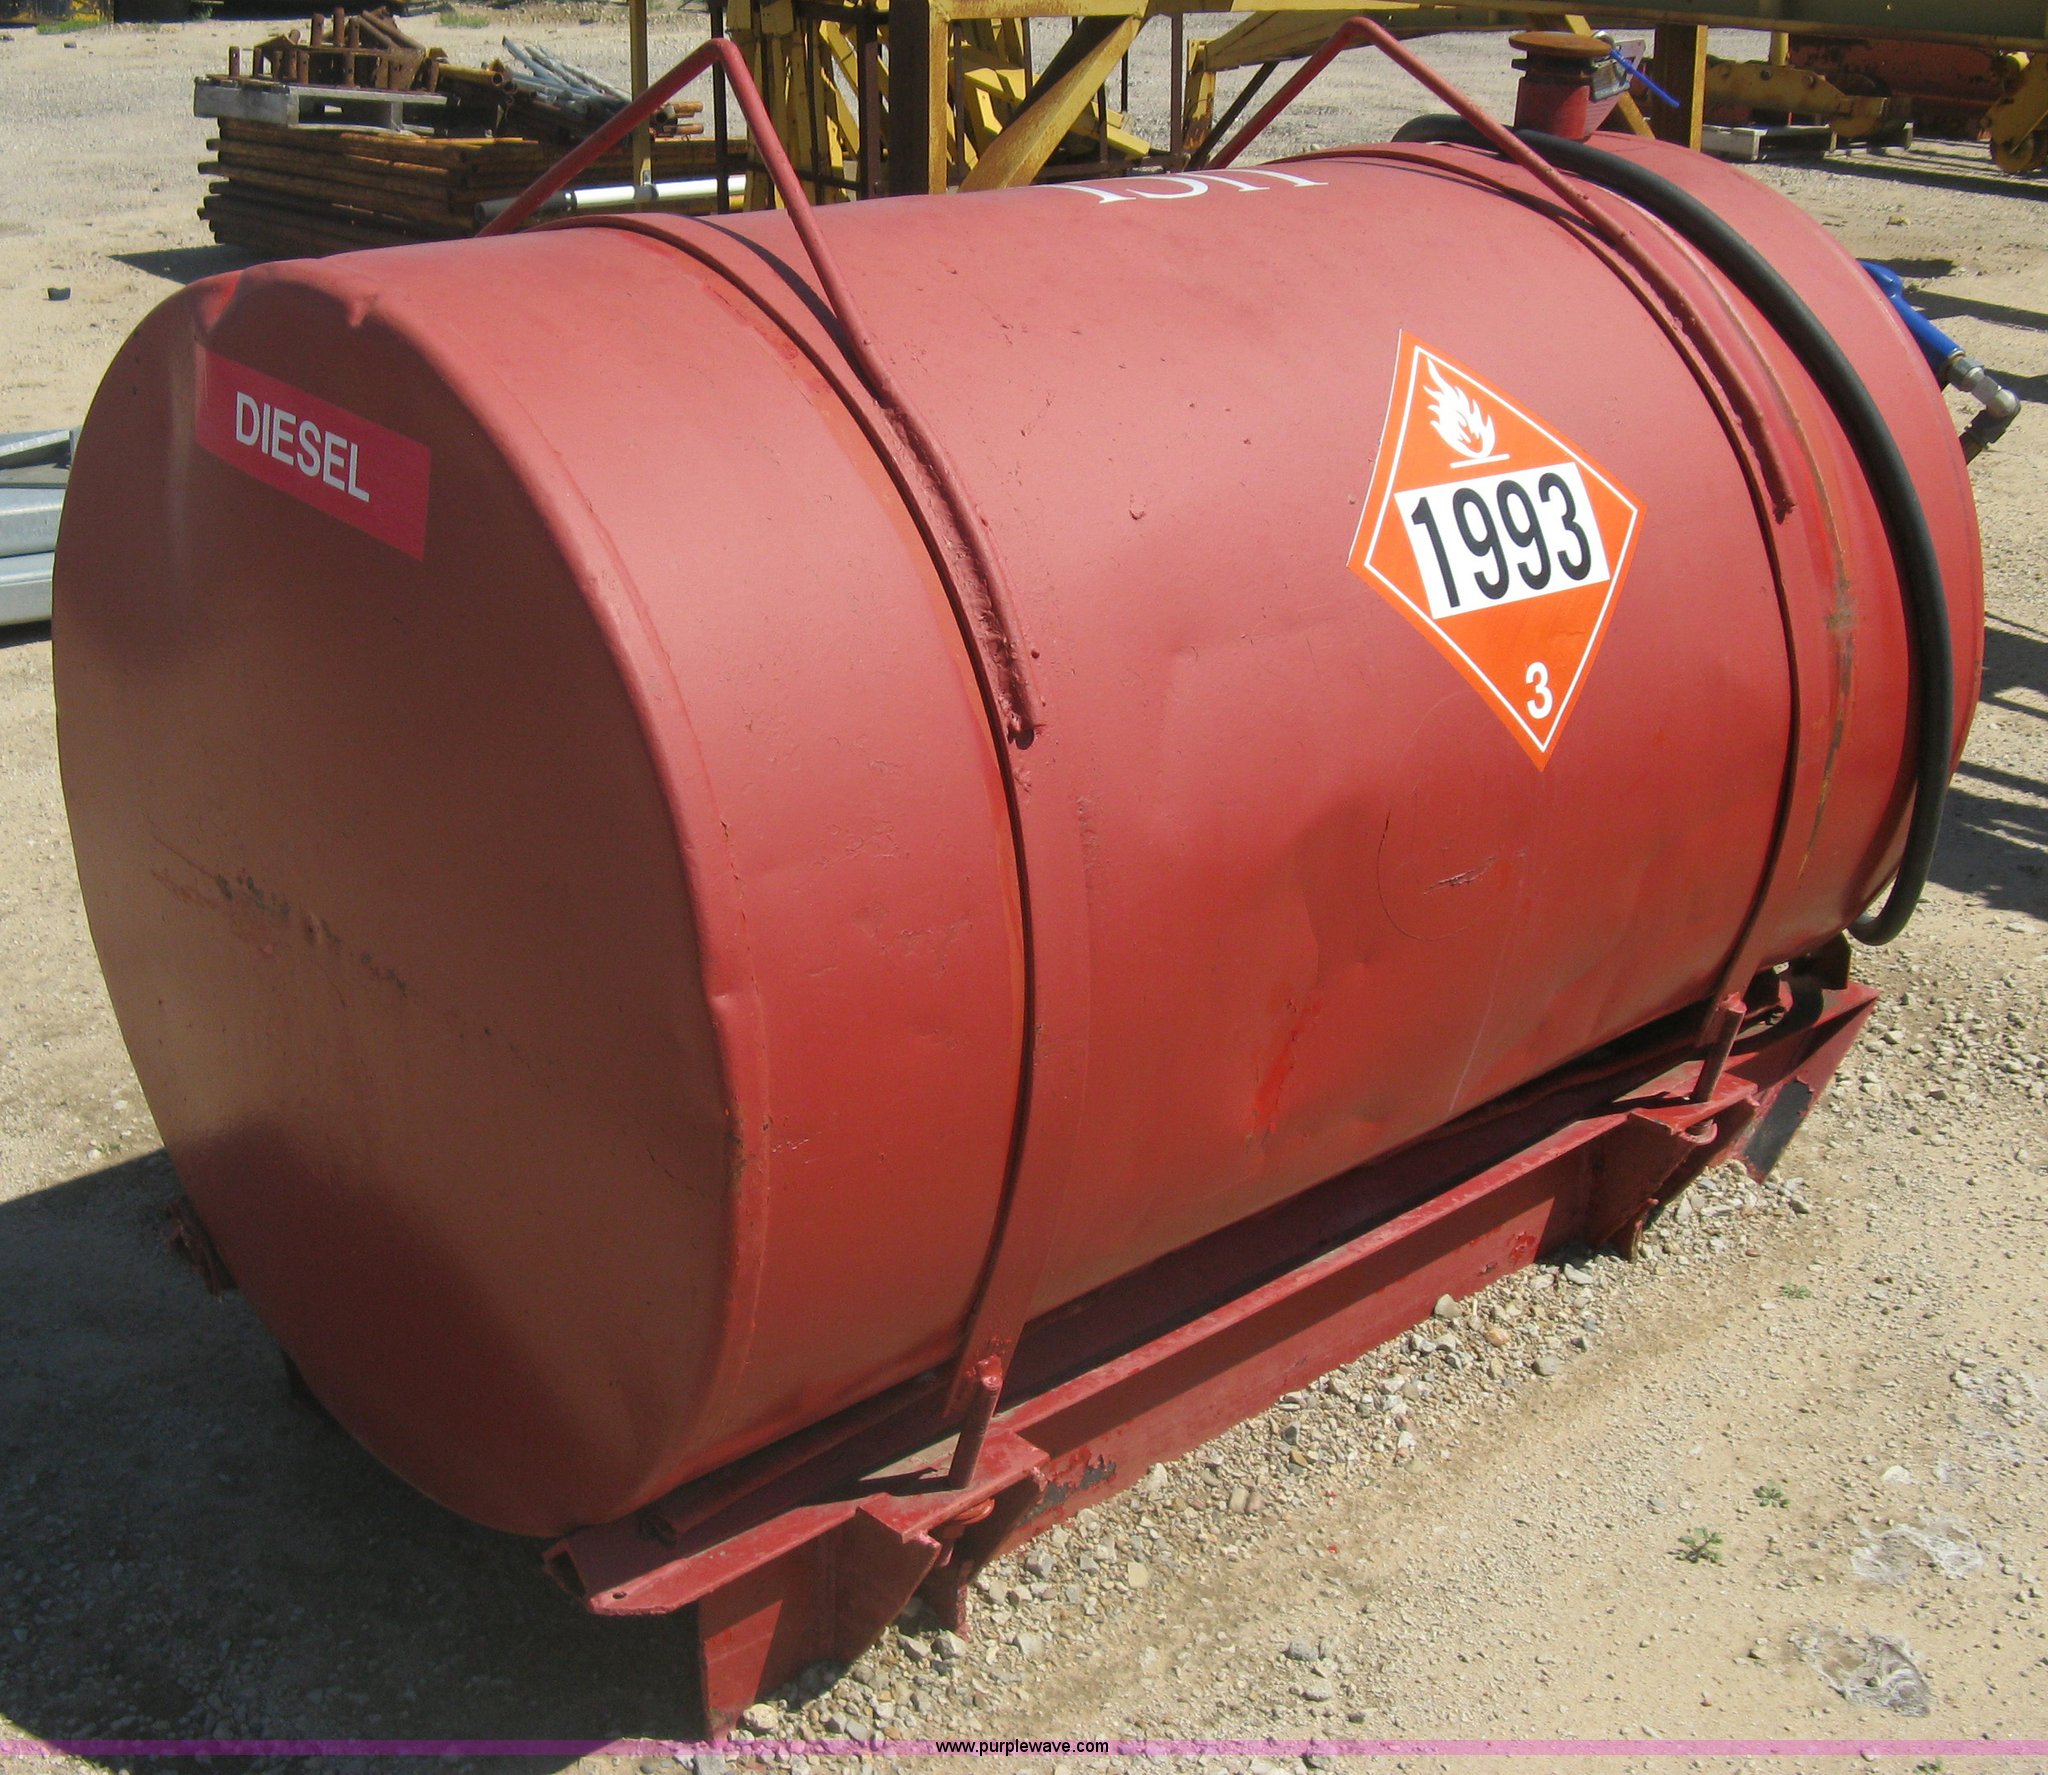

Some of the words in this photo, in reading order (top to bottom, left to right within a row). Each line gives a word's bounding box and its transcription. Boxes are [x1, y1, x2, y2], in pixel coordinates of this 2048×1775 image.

[235, 390, 371, 504] DIESEL
[1410, 471, 1592, 609] 1993
[1524, 660, 1554, 720] 3
